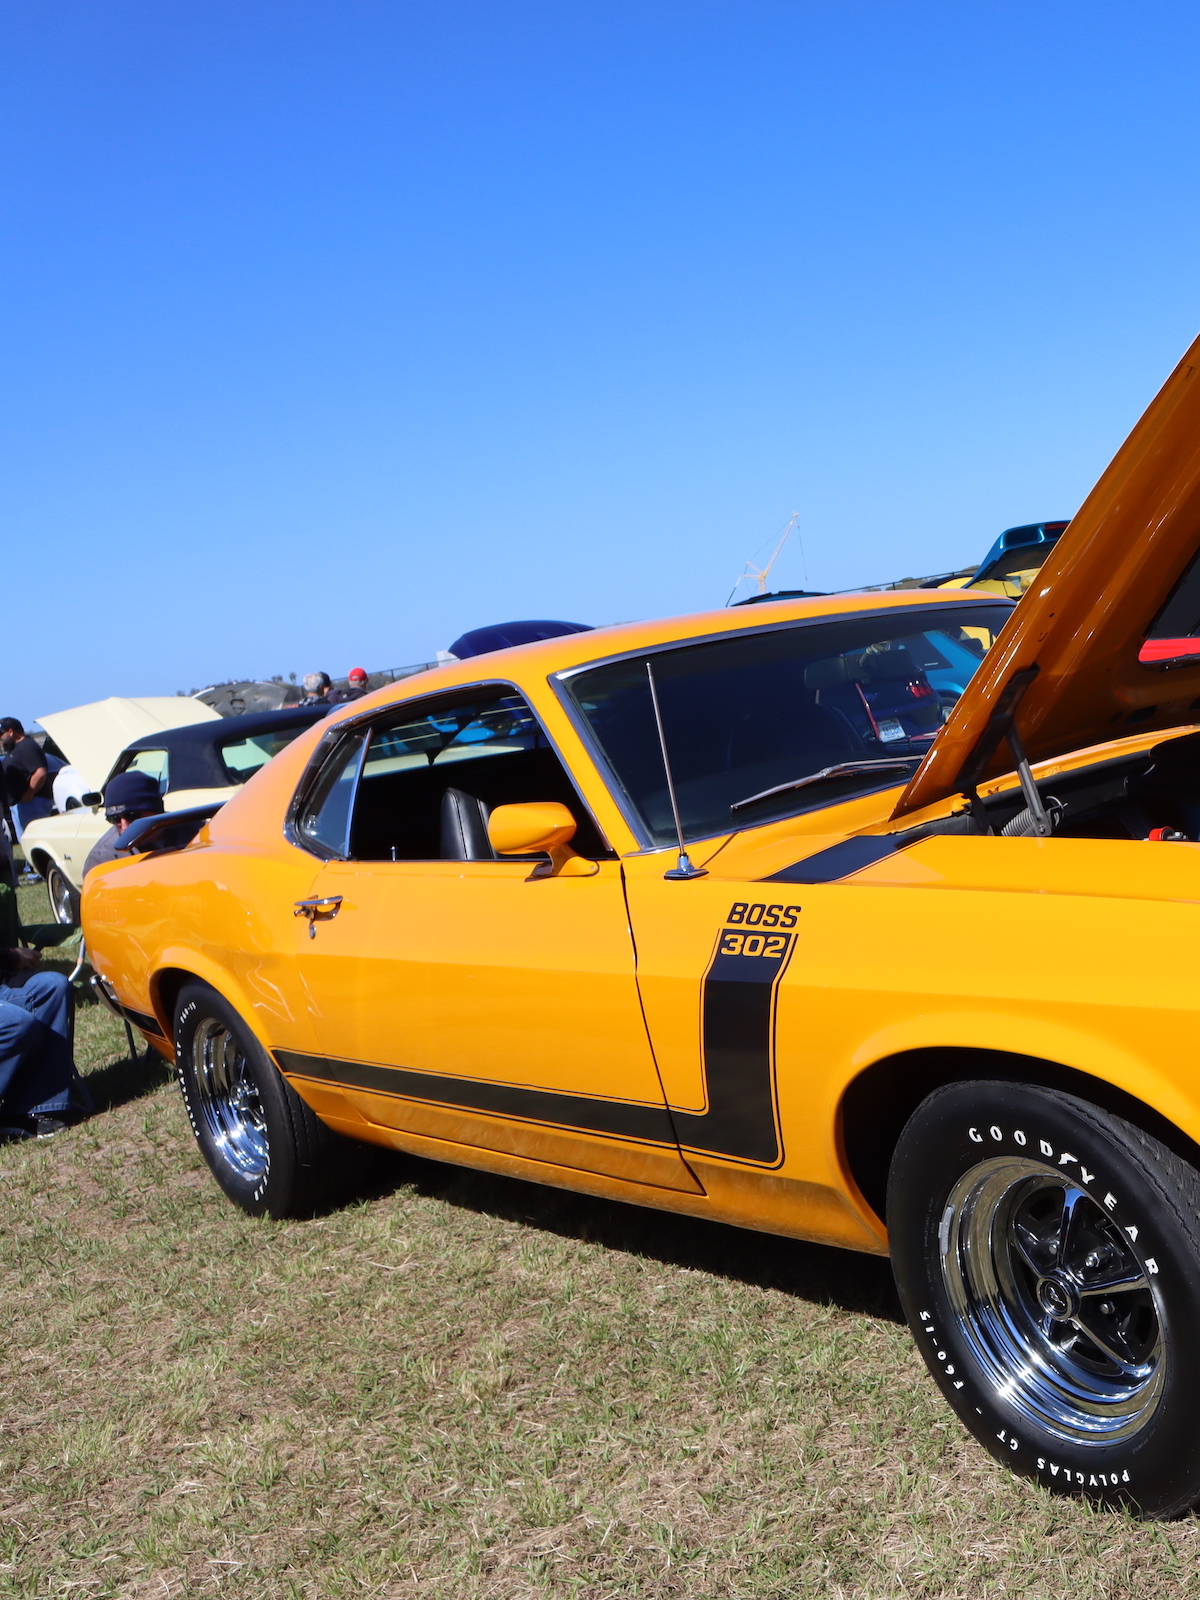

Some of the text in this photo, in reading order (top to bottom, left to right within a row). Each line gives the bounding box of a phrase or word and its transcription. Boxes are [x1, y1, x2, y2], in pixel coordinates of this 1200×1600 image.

[726, 902, 802, 928] BOSS
[720, 933, 787, 958] 302
[968, 1125, 1160, 1275] GOODYEAR
[919, 1310, 965, 1390] F60-15
[996, 1429, 1020, 1451] GT
[1036, 1457, 1131, 1487] POLYGLAS
